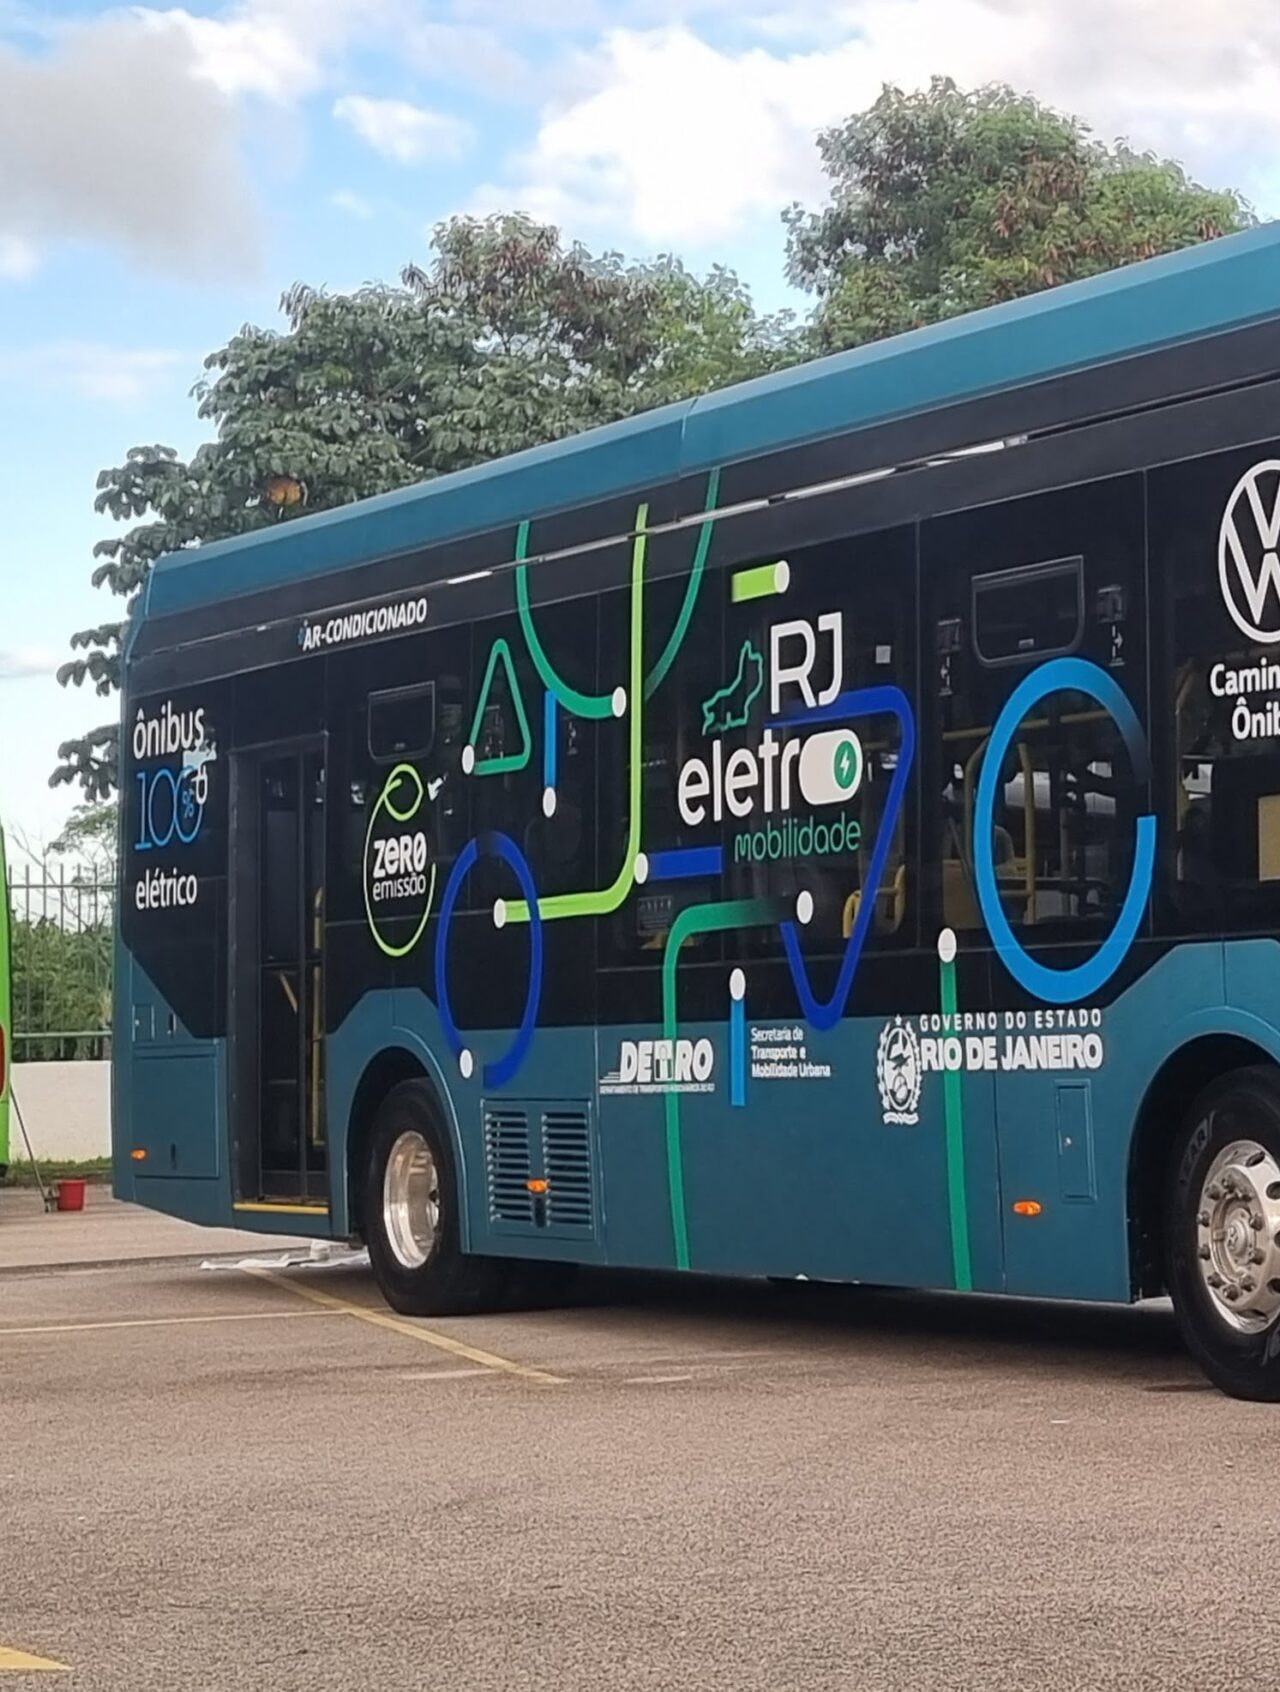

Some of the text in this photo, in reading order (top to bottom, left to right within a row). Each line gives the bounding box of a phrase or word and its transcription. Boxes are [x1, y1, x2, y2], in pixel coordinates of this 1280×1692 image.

[302, 598, 428, 651] AR-CONDICIONADO
[770, 611, 843, 715] RJ
[133, 700, 205, 760] ônibus
[734, 812, 862, 863] mobilidade
[135, 867, 198, 910] elétrico
[372, 872, 427, 902] emissão
[750, 1025, 804, 1042] Secretaria de
[919, 1008, 1102, 1032] GOVERNO DO ESTADO
[750, 1045, 807, 1061] Transporte e
[751, 1061, 832, 1078] Mobilidade Urbana
[920, 1033, 1104, 1072] RIO DE JANEIRO
